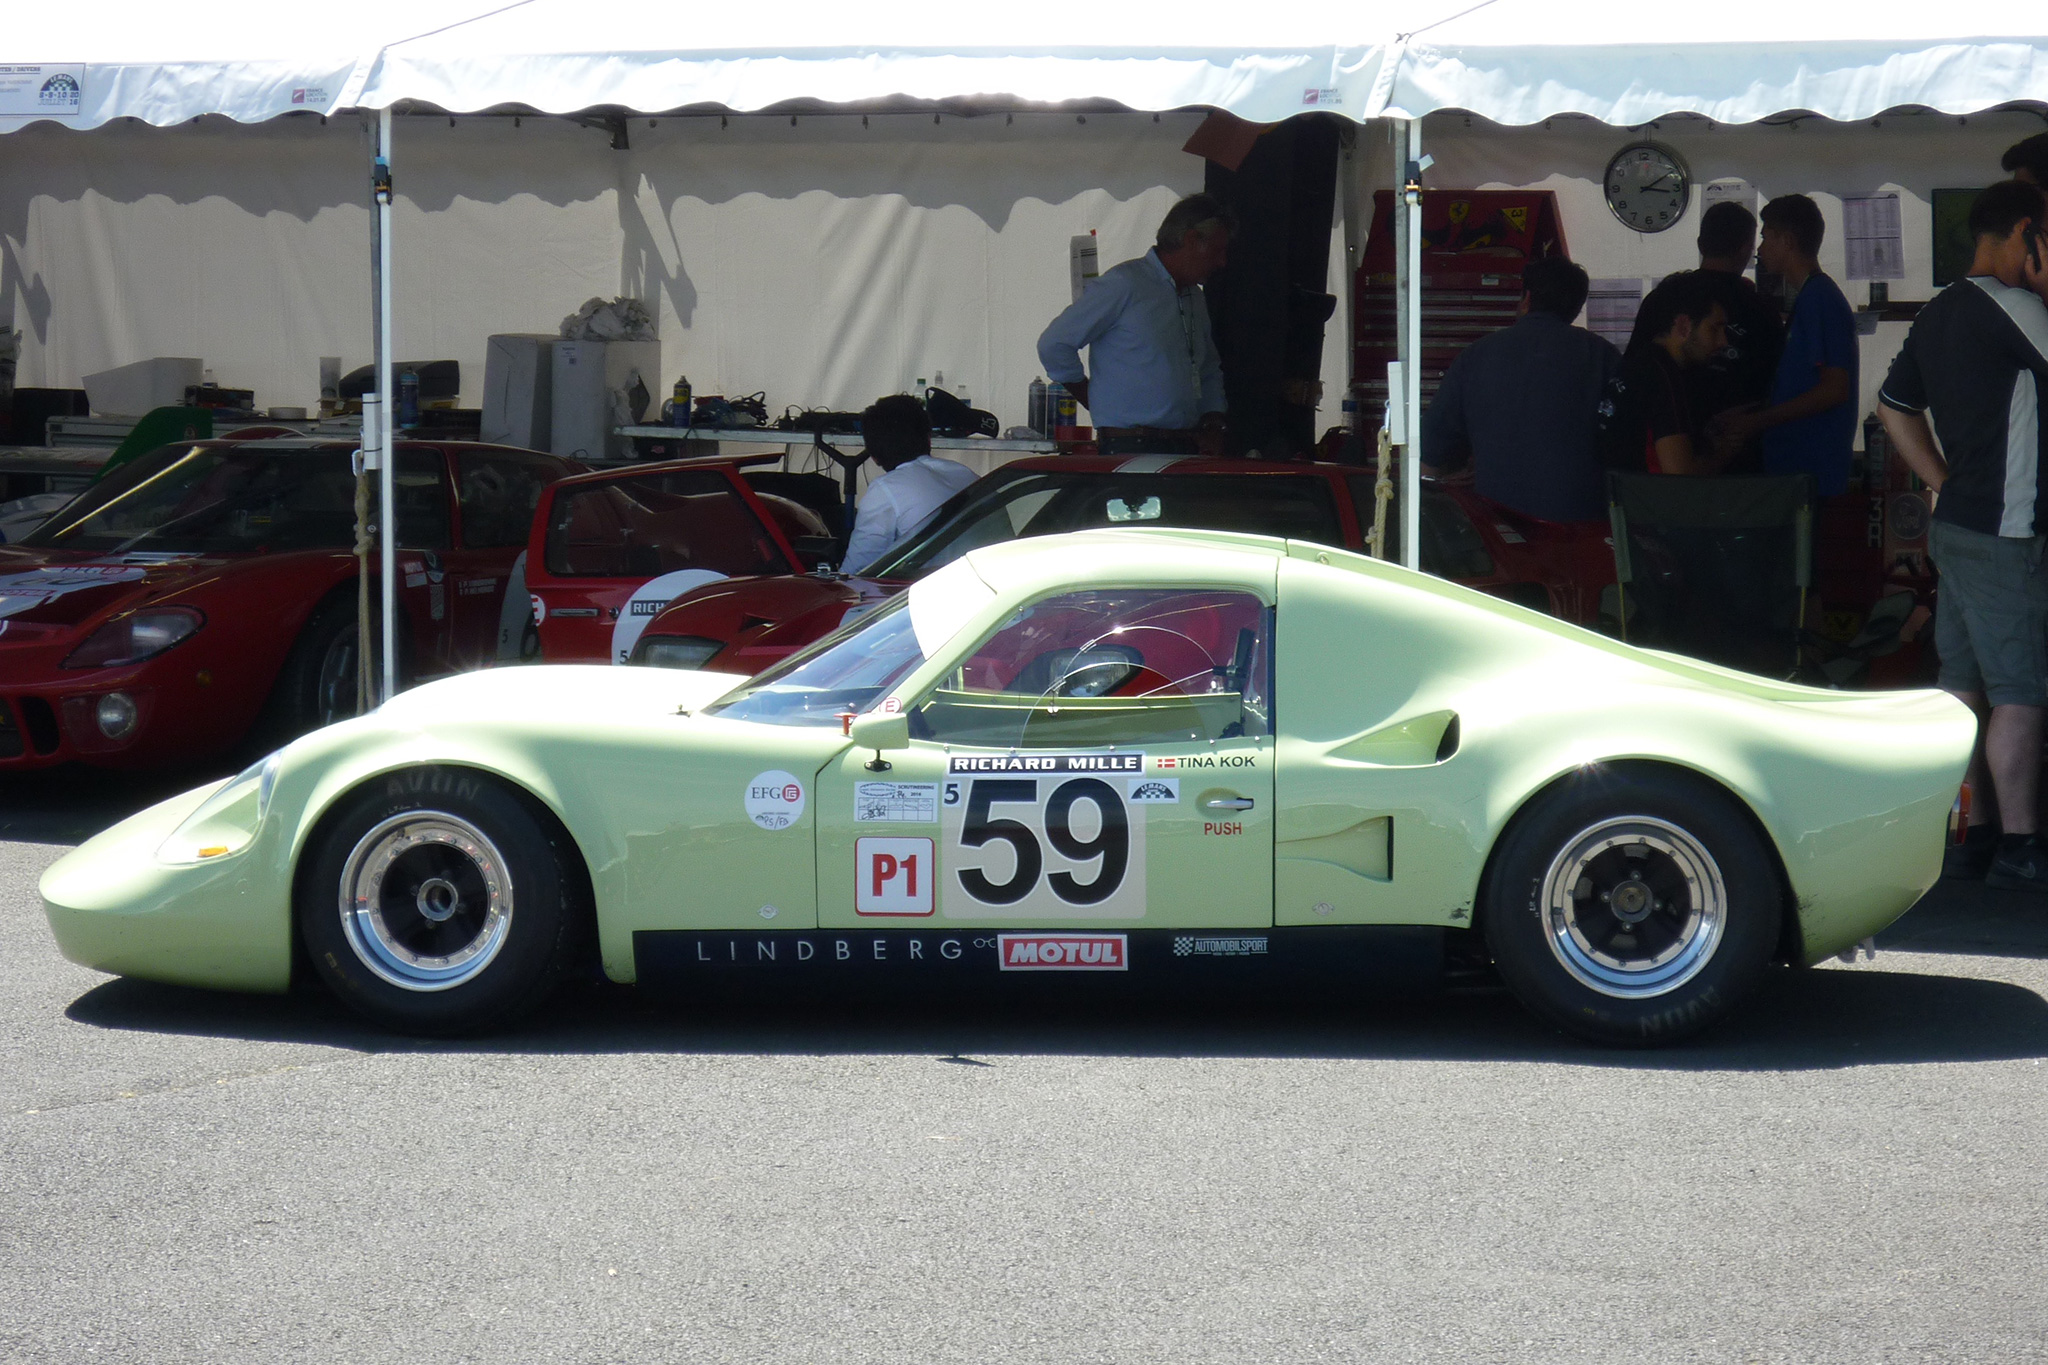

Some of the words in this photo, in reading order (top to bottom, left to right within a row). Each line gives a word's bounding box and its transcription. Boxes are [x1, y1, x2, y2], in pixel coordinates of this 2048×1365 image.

[1639, 152, 1650, 161] 12
[1612, 184, 1620, 193] 9
[1672, 183, 1681, 192] 3
[1619, 200, 1628, 209] 8
[1669, 198, 1677, 207] 4
[1630, 211, 1638, 221] 7
[1644, 216, 1653, 225] 6
[1659, 211, 1668, 220] 5
[633, 602, 665, 614] RICH
[954, 757, 1056, 771] RICHARD
[1068, 756, 1138, 770] MILLE
[1178, 757, 1215, 768] TINA
[1220, 756, 1256, 768] KOK
[751, 786, 781, 800] EFG
[943, 783, 960, 805] 5
[1204, 822, 1242, 836] PUSH
[956, 778, 1130, 907] 59
[872, 853, 917, 897] P1
[697, 939, 963, 961] LINDBERG
[1009, 941, 1118, 963] MOTUL
[1194, 940, 1268, 952] AUTOMOBILSPORT
